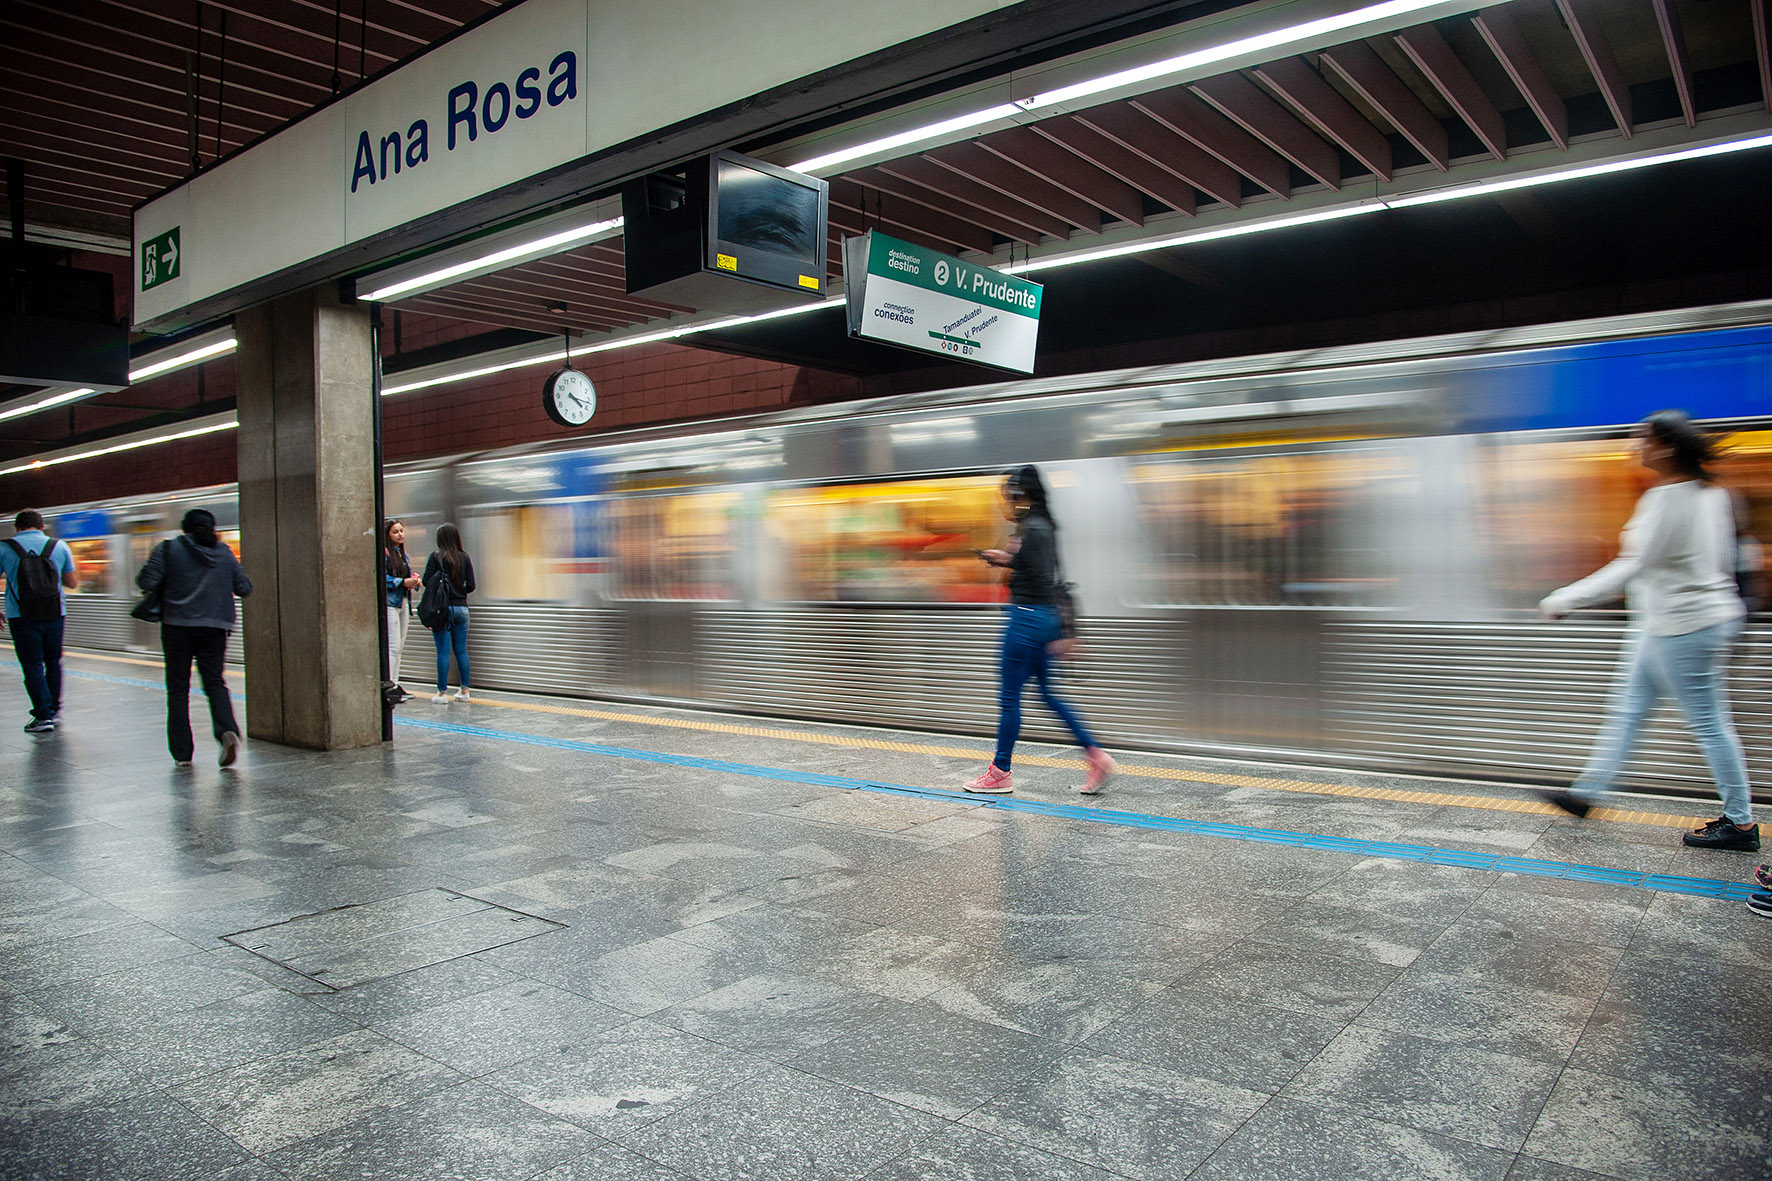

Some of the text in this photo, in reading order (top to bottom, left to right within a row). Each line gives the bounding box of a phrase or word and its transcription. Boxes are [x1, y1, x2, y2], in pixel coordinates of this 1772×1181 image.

[351, 50, 578, 193] Ana Rosa
[888, 249, 921, 265] destination
[888, 257, 920, 275] destino
[937, 265, 1036, 309] 2 V. Prudente
[874, 308, 914, 325] conexões
[883, 302, 915, 315] connection
[964, 315, 998, 339] V. Prudente
